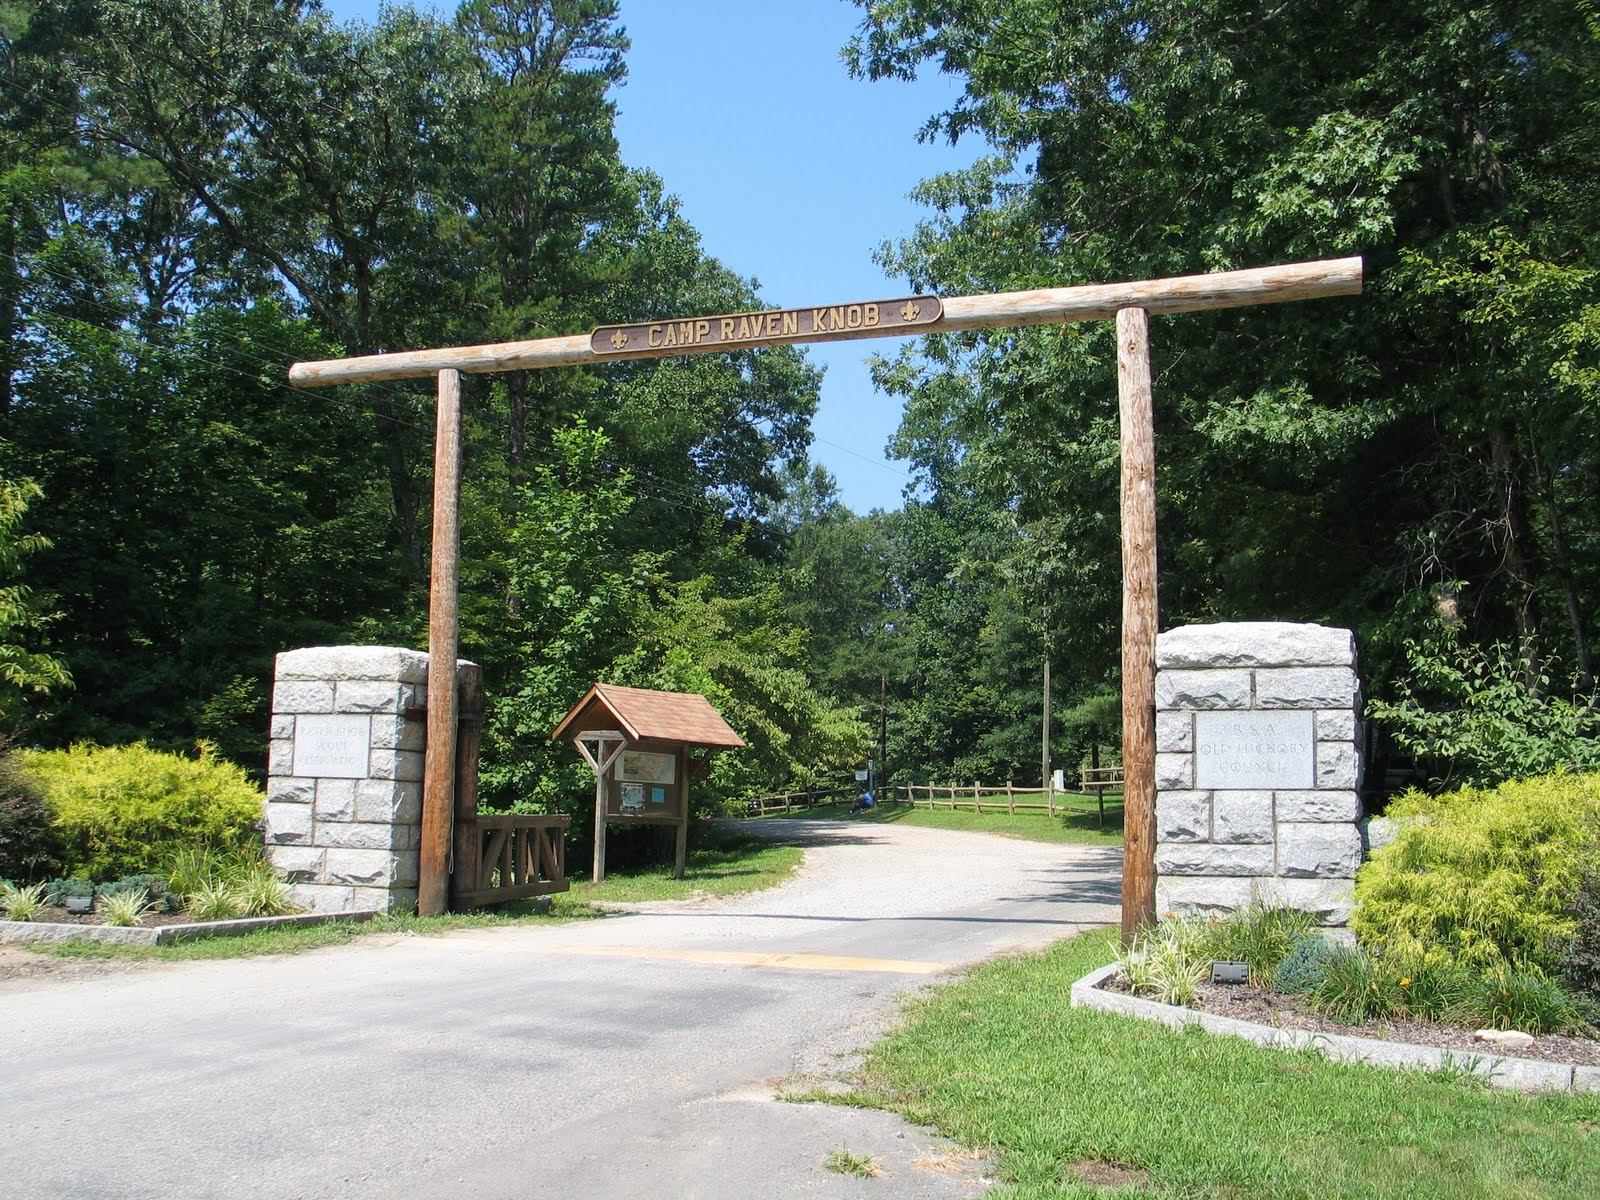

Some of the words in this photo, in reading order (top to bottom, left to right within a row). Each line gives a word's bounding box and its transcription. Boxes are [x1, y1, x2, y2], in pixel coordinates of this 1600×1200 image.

[648, 320, 711, 347] CAMP
[719, 312, 799, 341] RAVEN
[811, 302, 881, 332] KNOB
[336, 727, 365, 737] KNOB
[315, 741, 348, 751] SCOUT
[1200, 743, 1231, 756] OLD
[1237, 743, 1309, 755] HICKORY
[1218, 761, 1287, 774] COUNCIL
